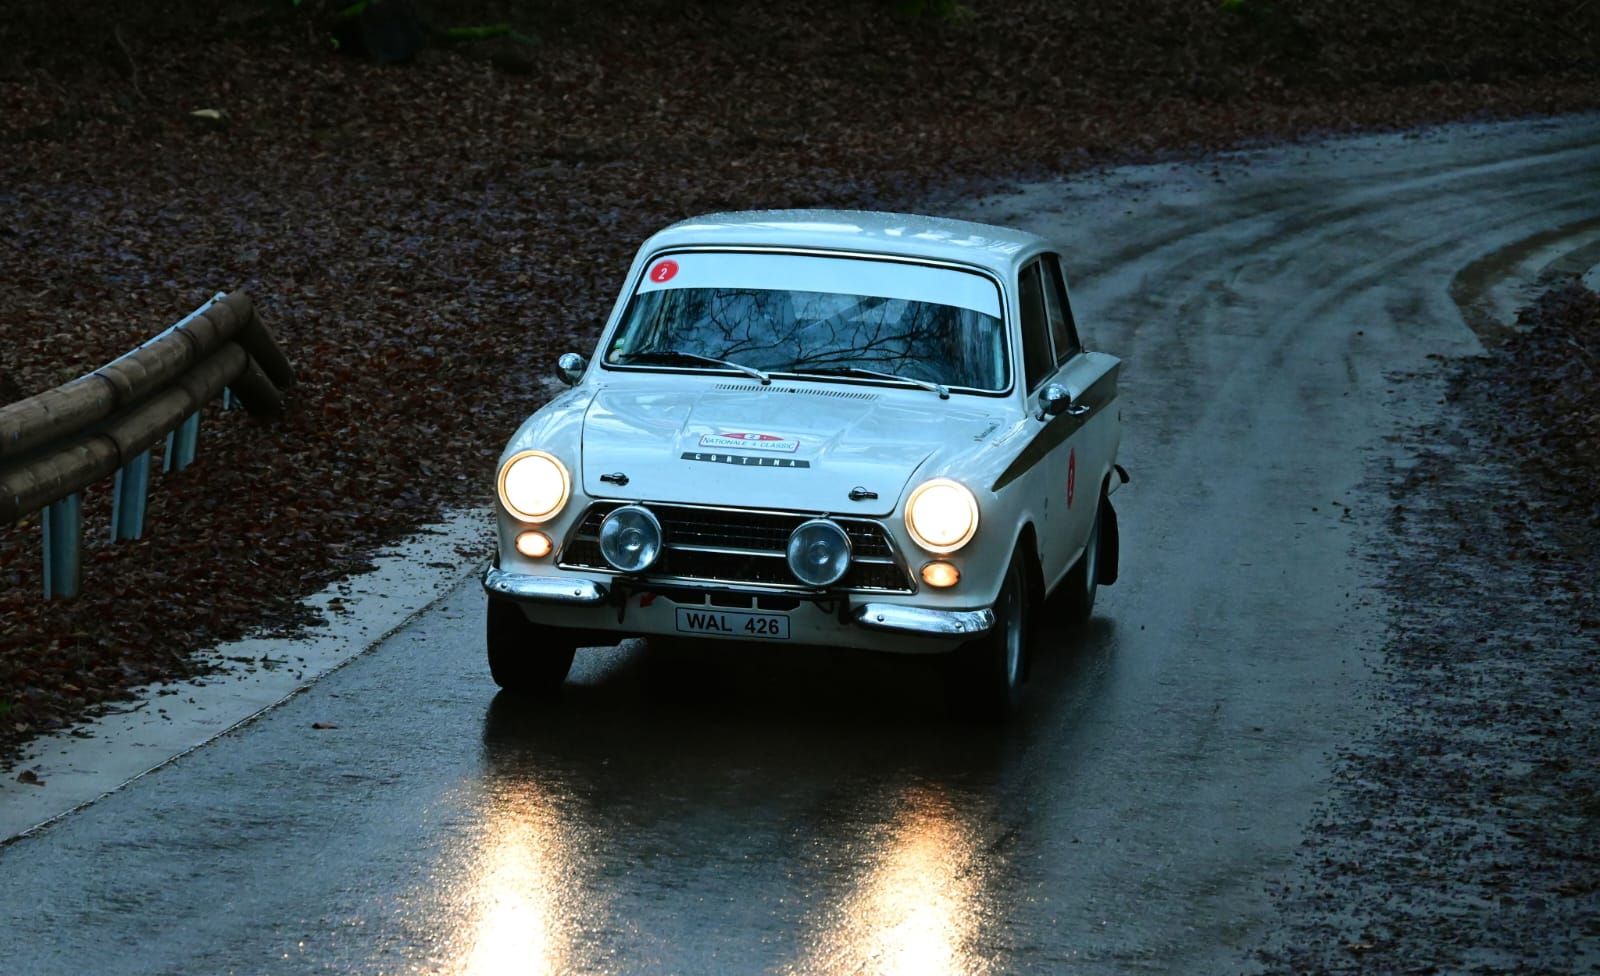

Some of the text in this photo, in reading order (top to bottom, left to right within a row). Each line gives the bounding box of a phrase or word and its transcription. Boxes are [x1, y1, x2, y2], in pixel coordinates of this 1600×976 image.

[658, 267, 668, 280] 2
[695, 453, 795, 467] CORTINA
[686, 612, 780, 635] WAL 426
